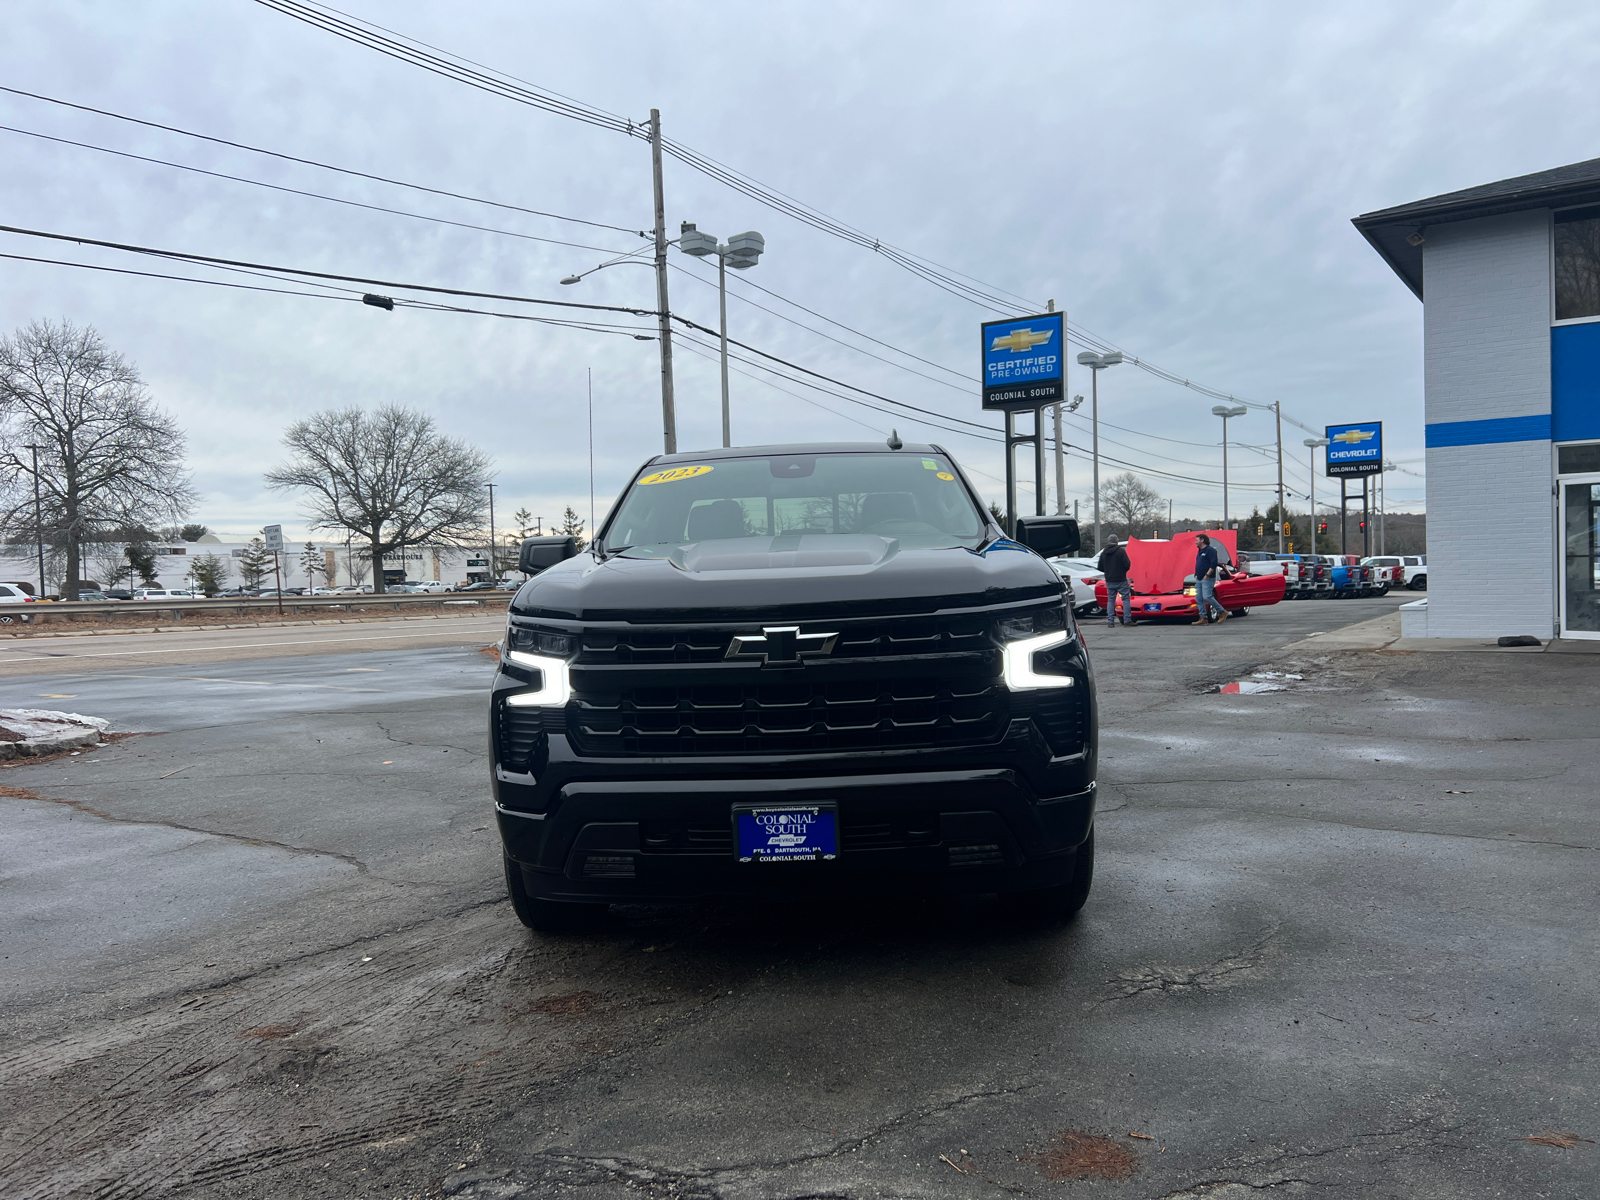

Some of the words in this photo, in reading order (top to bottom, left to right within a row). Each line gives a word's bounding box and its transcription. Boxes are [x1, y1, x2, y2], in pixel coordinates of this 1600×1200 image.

[988, 355, 1057, 371] CERTIFIED
[991, 364, 1053, 379] PRE-OWNED
[990, 391, 1026, 401] COLONIAL
[1030, 387, 1055, 397] SOUTH
[1330, 448, 1378, 459] CHEVROLET
[648, 467, 701, 483] 2023
[756, 814, 816, 825] COLONIAL
[765, 824, 806, 834] SOUTH
